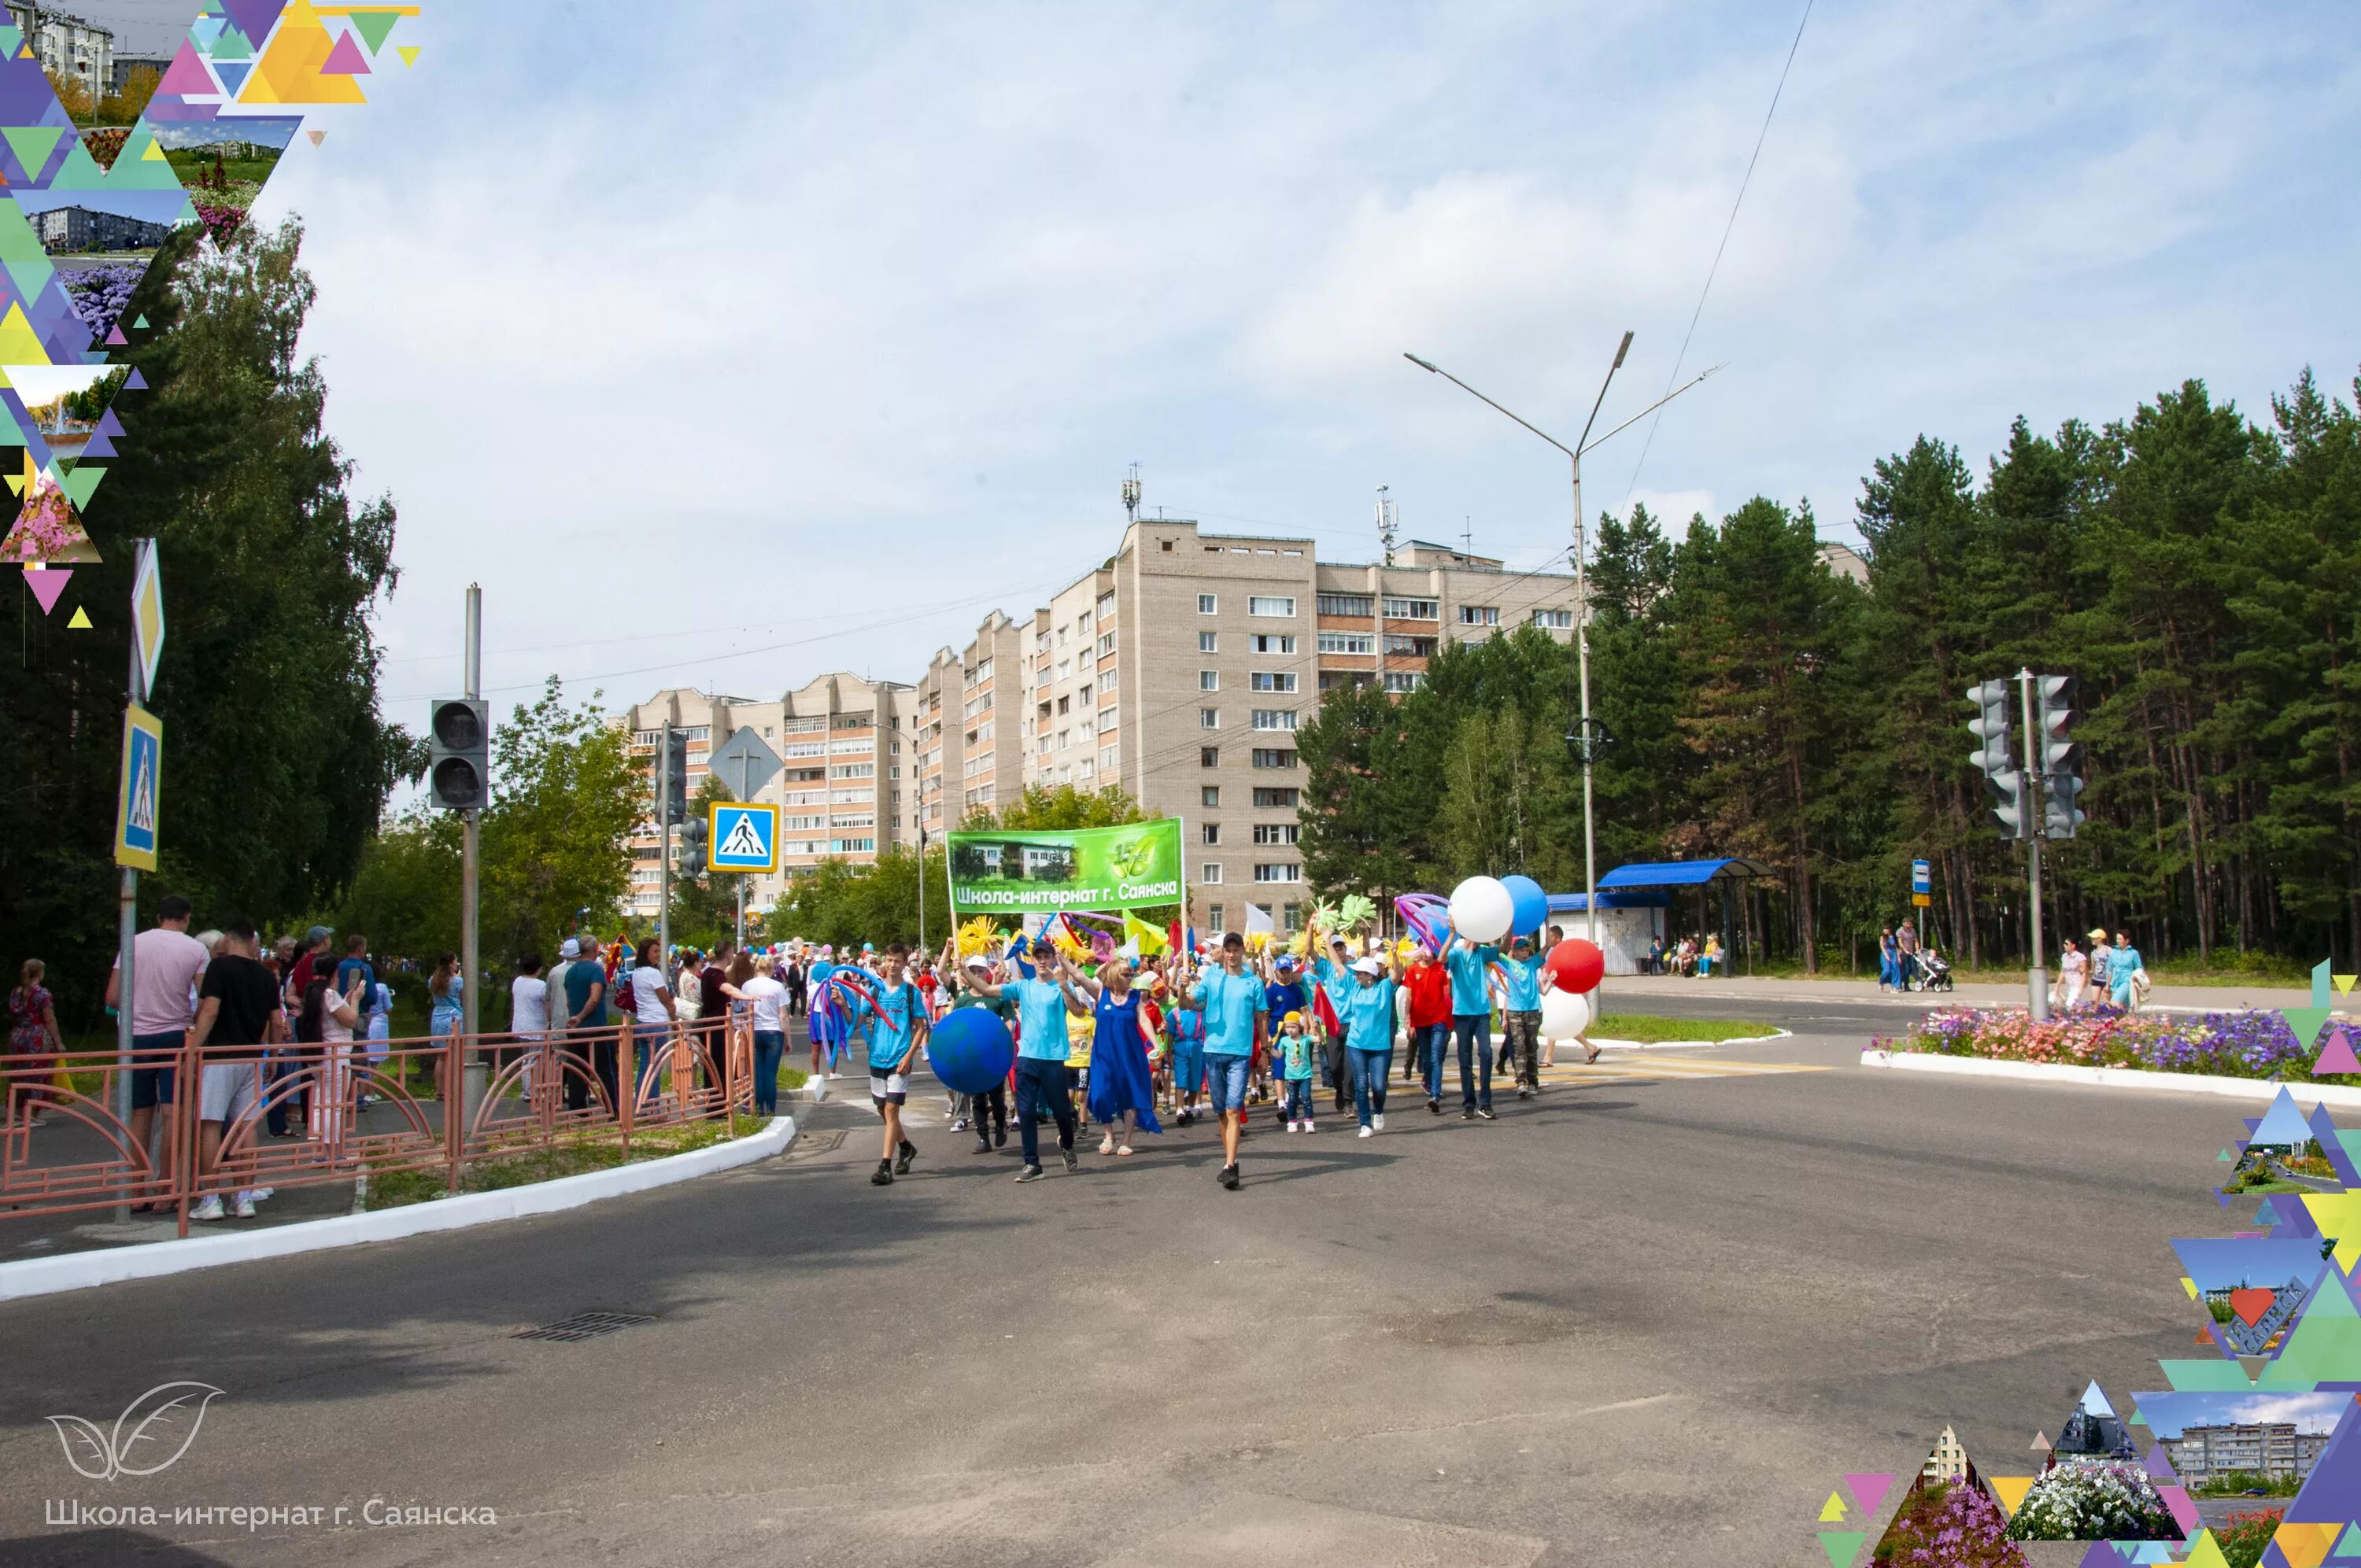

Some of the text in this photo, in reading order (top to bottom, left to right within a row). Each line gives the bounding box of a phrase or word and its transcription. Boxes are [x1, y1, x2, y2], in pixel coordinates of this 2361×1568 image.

[956, 881, 1177, 908] Школа-интернат г. Саянска
